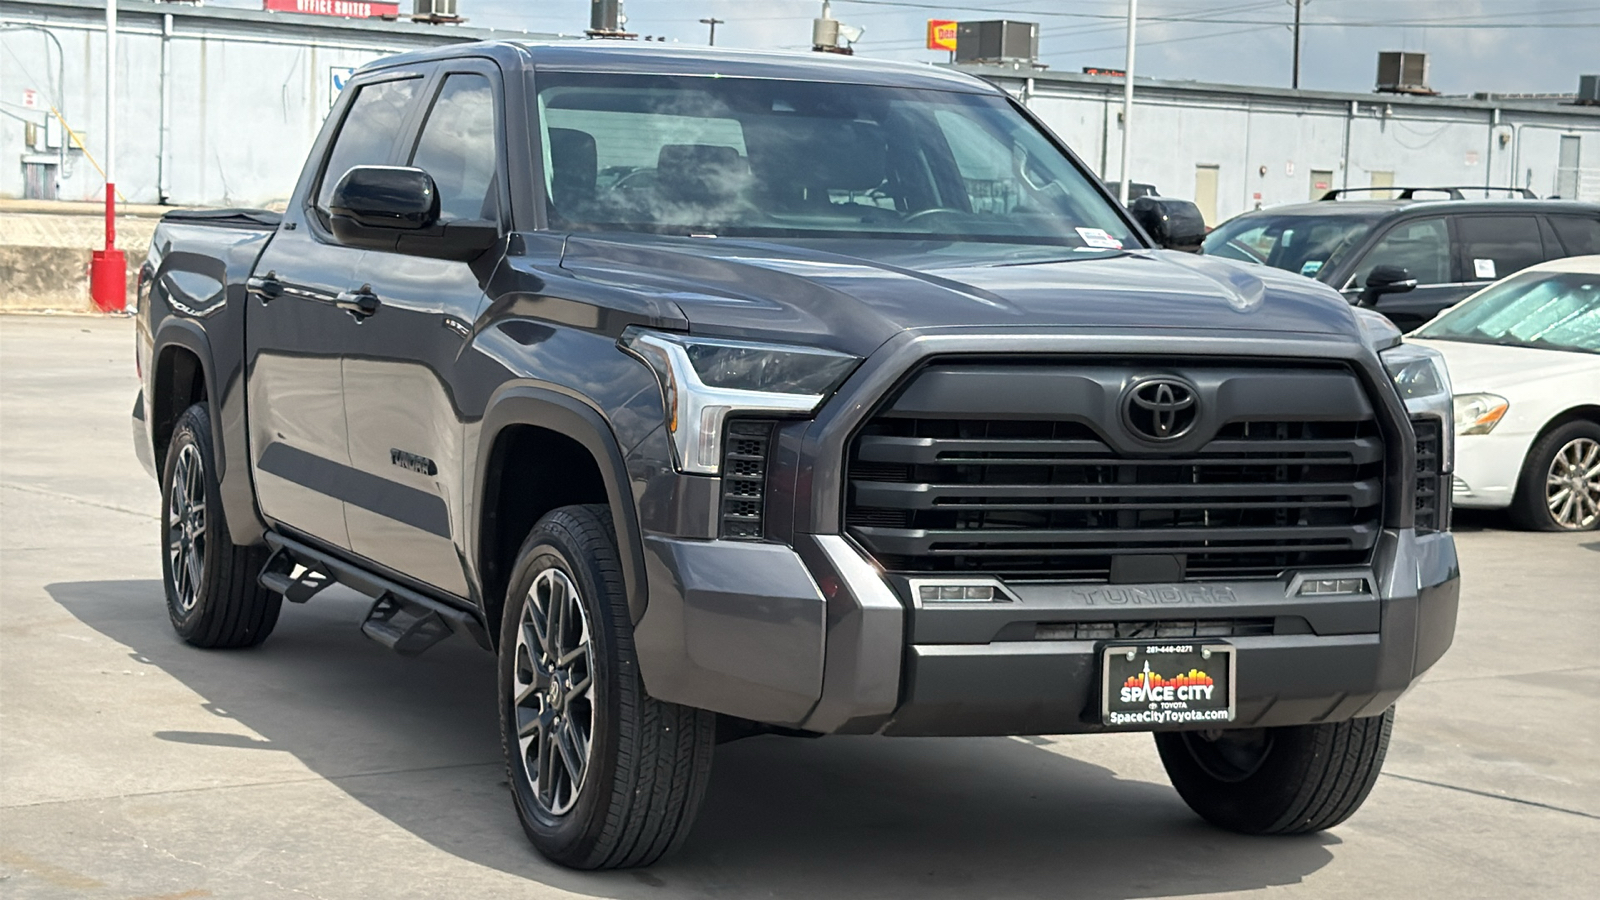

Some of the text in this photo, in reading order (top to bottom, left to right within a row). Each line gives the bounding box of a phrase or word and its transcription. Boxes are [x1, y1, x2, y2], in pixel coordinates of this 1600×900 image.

[297, 0, 371, 16] OFFICE SUITES
[390, 448, 431, 476] TUNDRA
[1072, 586, 1237, 605] TUNDRA
[1120, 685, 1214, 702] SPACE CITY
[1110, 710, 1228, 724] SpaceCityToyota.com
